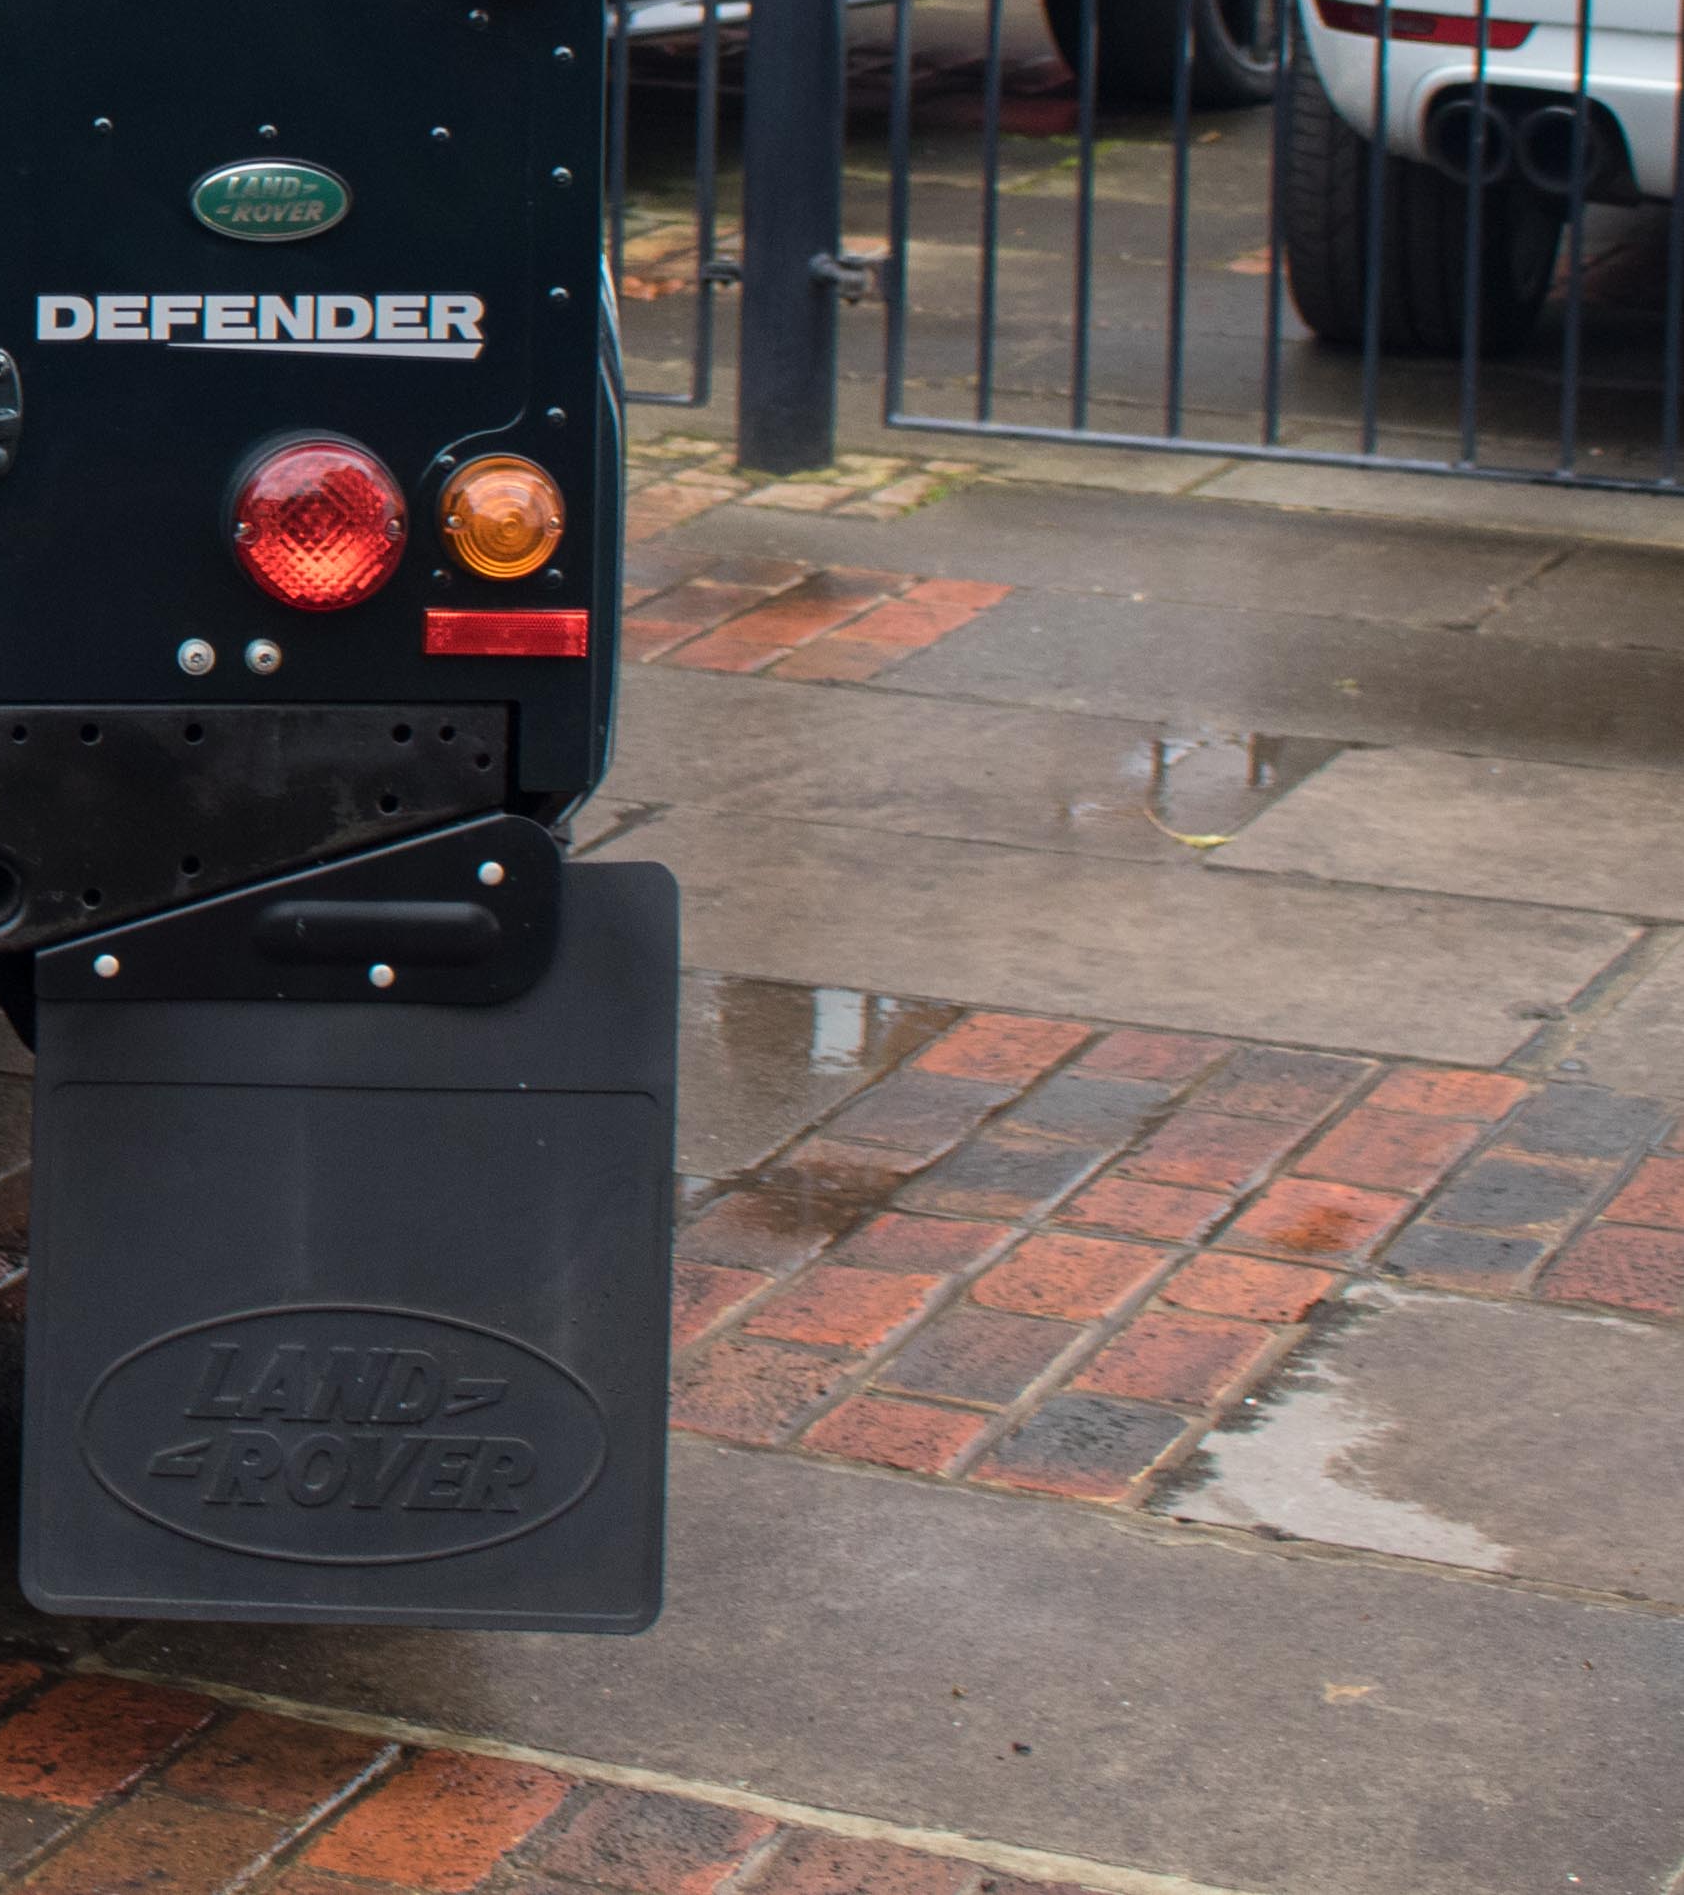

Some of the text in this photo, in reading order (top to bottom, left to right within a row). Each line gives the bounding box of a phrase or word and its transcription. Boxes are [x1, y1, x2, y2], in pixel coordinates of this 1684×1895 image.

[224, 176, 301, 199] LAND
[232, 200, 326, 223] ROVER
[36, 295, 485, 341] DEFENDER
[183, 1343, 438, 1424] LAND
[203, 1430, 534, 1512] ROVER
